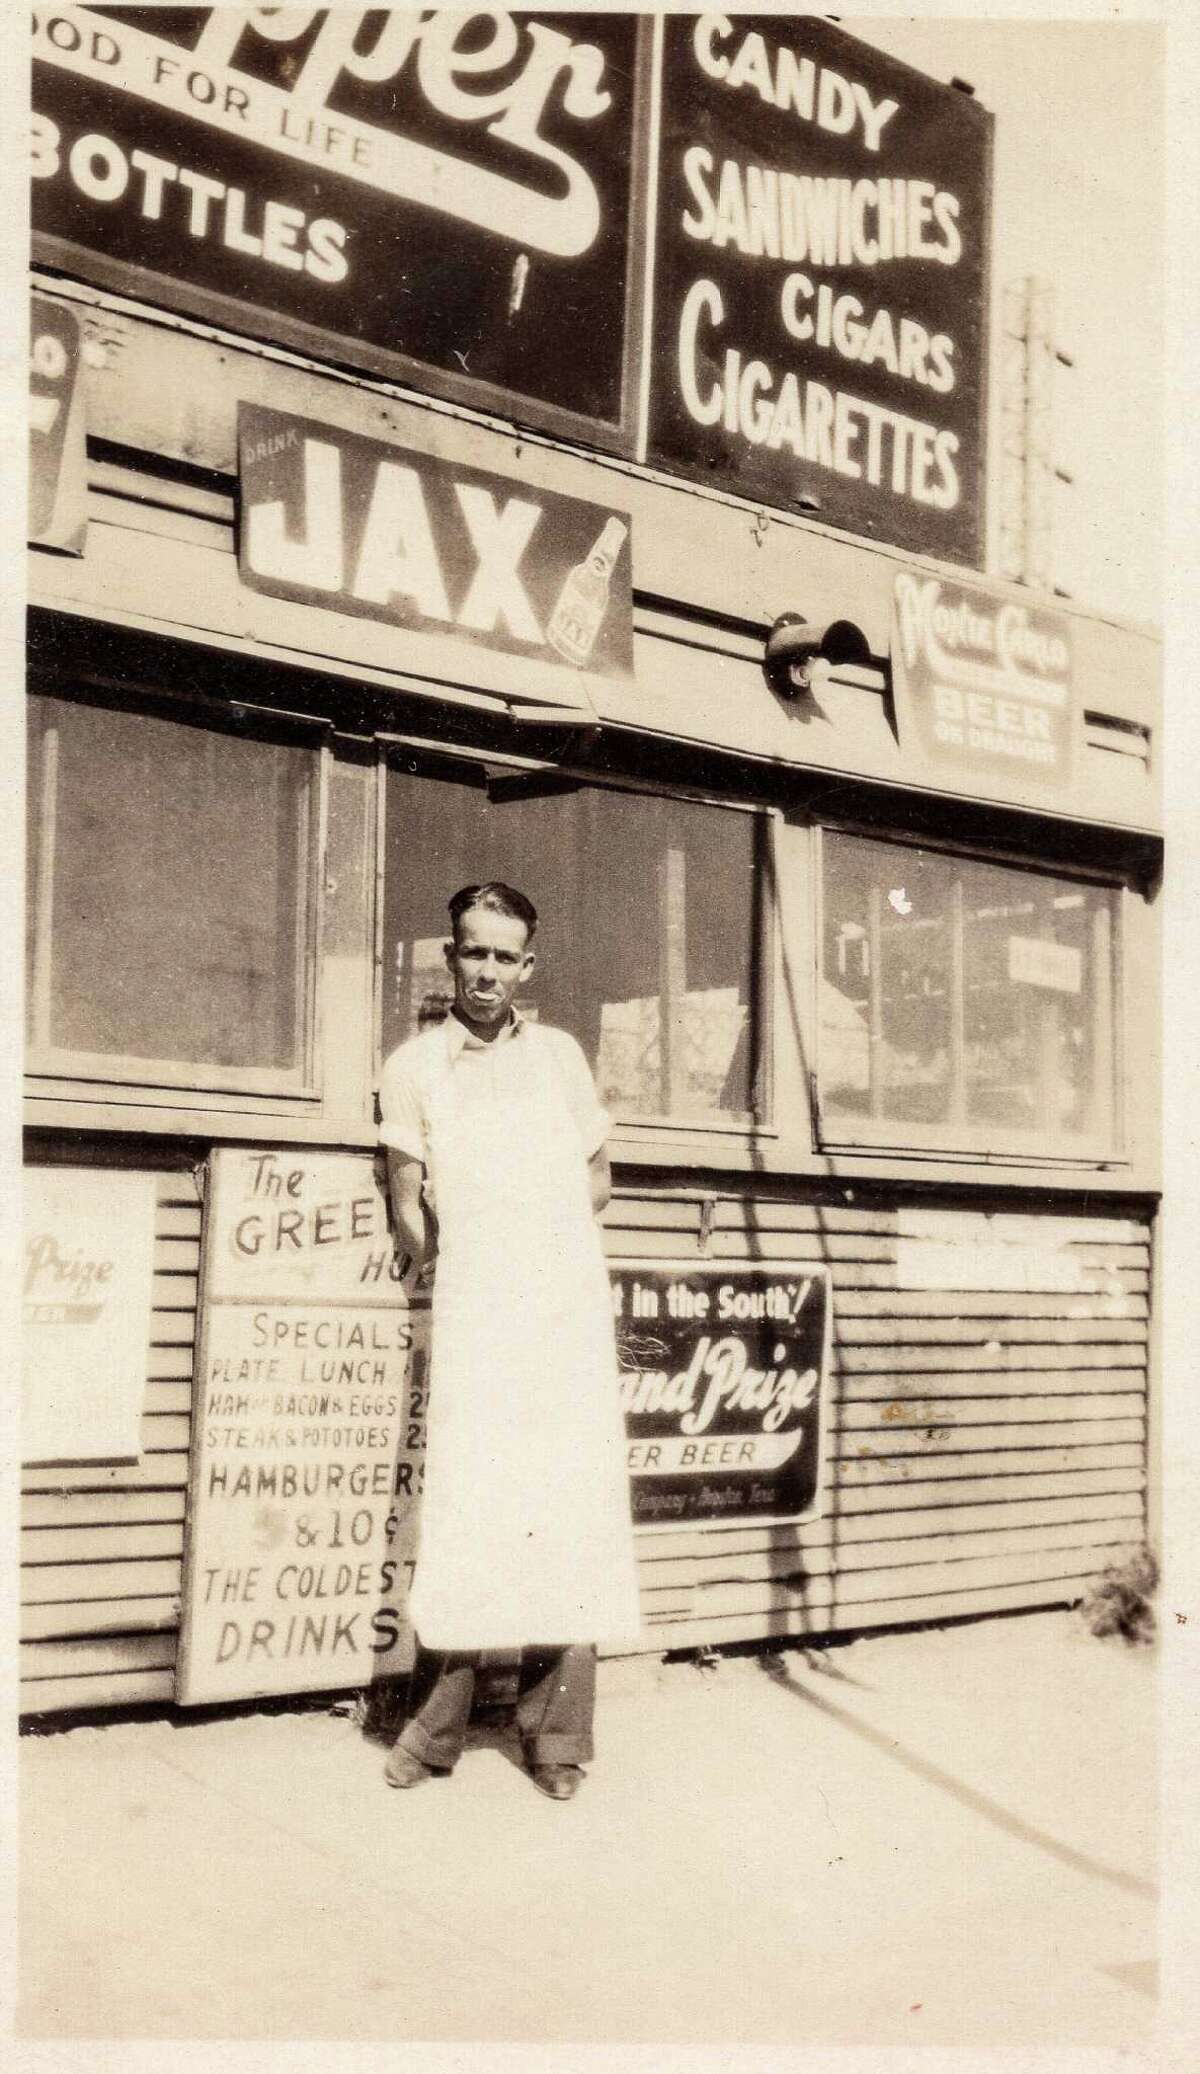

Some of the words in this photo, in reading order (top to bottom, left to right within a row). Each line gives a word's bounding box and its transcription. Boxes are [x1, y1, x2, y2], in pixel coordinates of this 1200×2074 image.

[693, 12, 899, 151] CANDY
[153, 56, 250, 121] FOR
[279, 108, 373, 169] LIFE
[683, 146, 962, 266] SANDWICHES
[781, 273, 955, 394] CIGARS
[678, 279, 960, 511] CIGARETTES
[244, 429, 299, 466] DRINK
[248, 438, 547, 646] JAX
[932, 685, 1051, 739] BEER
[248, 1153, 306, 1198] The
[235, 1198, 375, 1256] GREE
[22, 1232, 113, 1298] Prize
[632, 1282, 658, 1318] in
[666, 1283, 710, 1318] the
[252, 1313, 415, 1351] SPECIALS
[210, 1359, 285, 1384] PLATE
[300, 1361, 388, 1385] LUNCH
[680, 1336, 818, 1435] Prize
[409, 1391, 430, 1419] 2
[680, 1442, 757, 1466] BEER
[204, 1567, 262, 1604] THE
[215, 1607, 400, 1663] DRINKS
